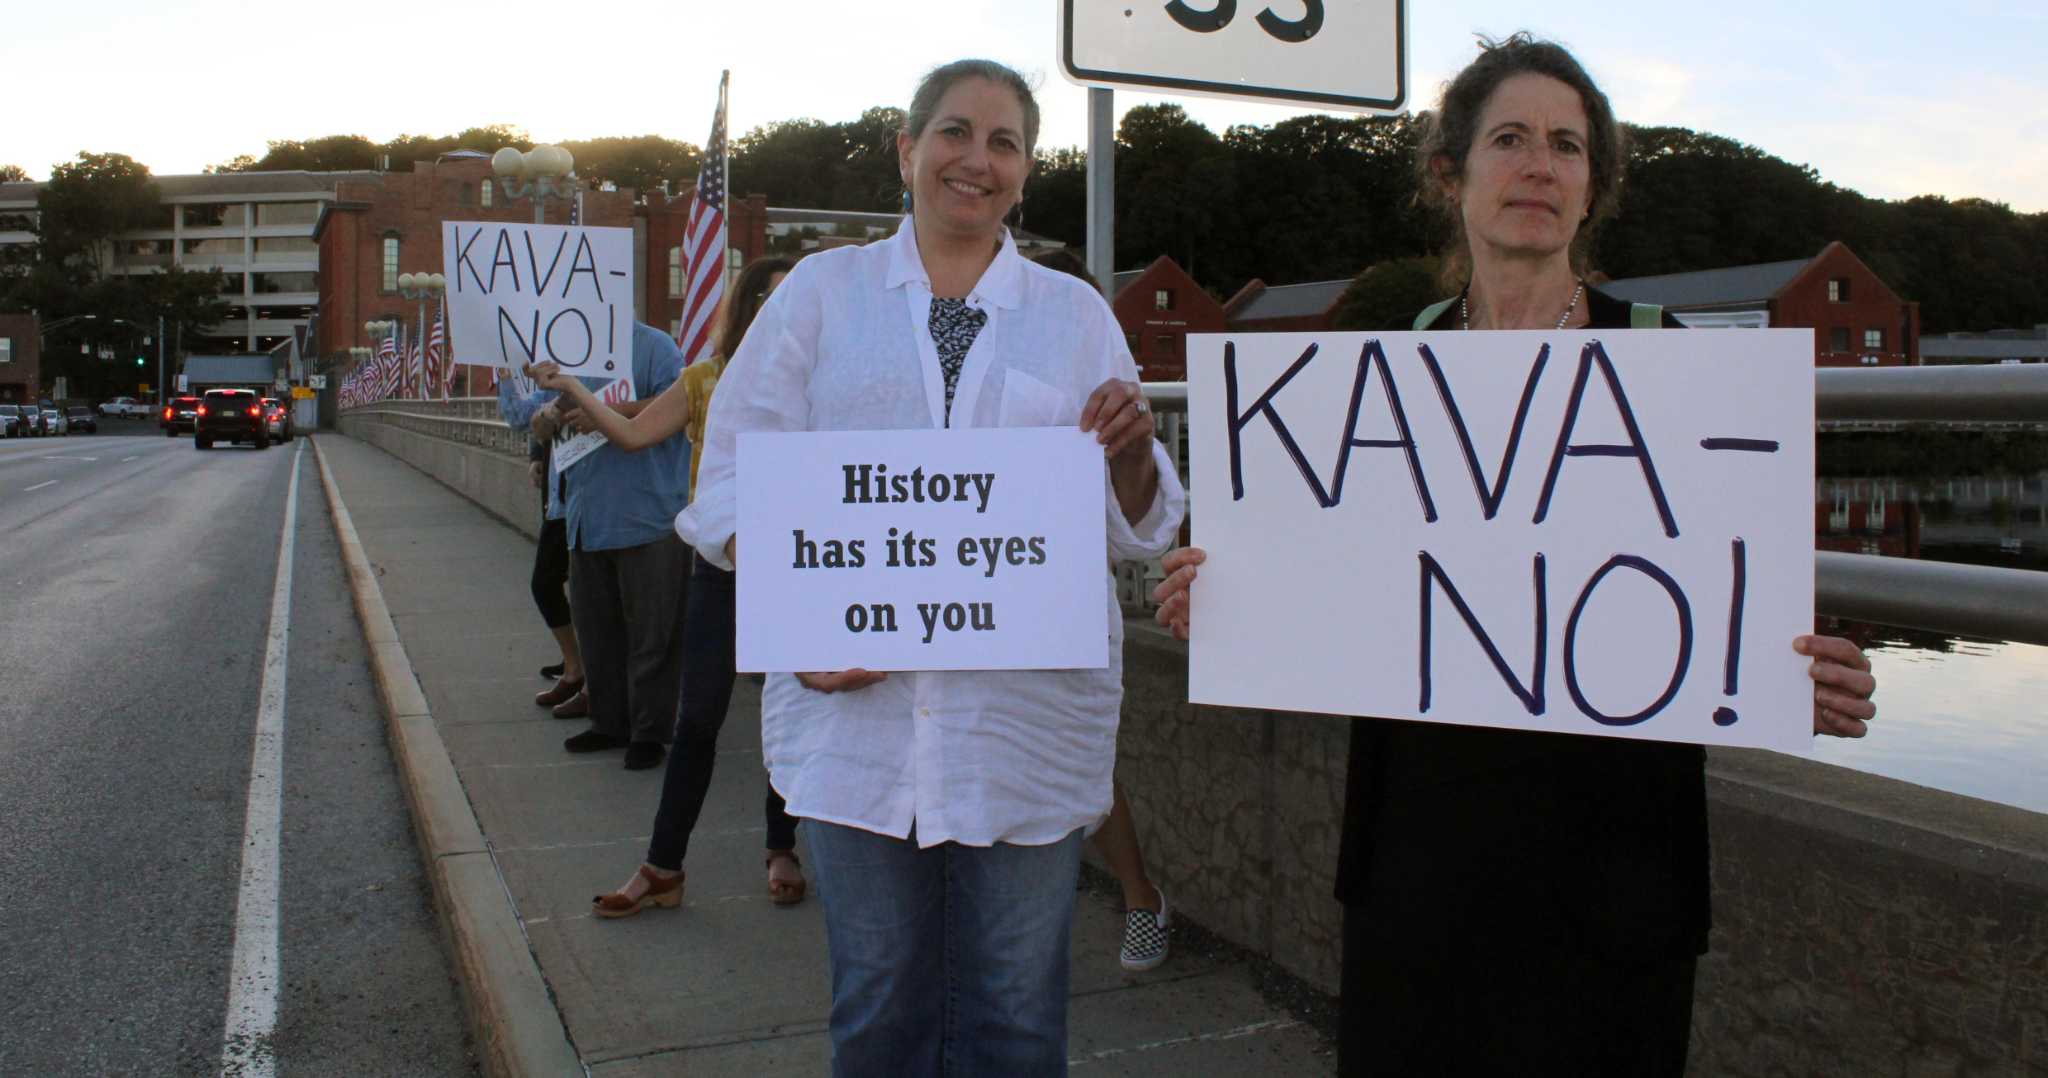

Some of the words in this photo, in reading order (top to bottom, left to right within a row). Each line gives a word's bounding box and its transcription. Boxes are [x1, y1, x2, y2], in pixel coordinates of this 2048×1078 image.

[498, 304, 614, 371] NO!
[604, 378, 630, 405] NO
[842, 463, 995, 514] History
[792, 529, 865, 569] has
[886, 527, 937, 568] its
[957, 536, 1046, 578] eyes
[845, 603, 898, 633] on
[917, 602, 996, 644] you
[1419, 536, 1746, 727] NO!
